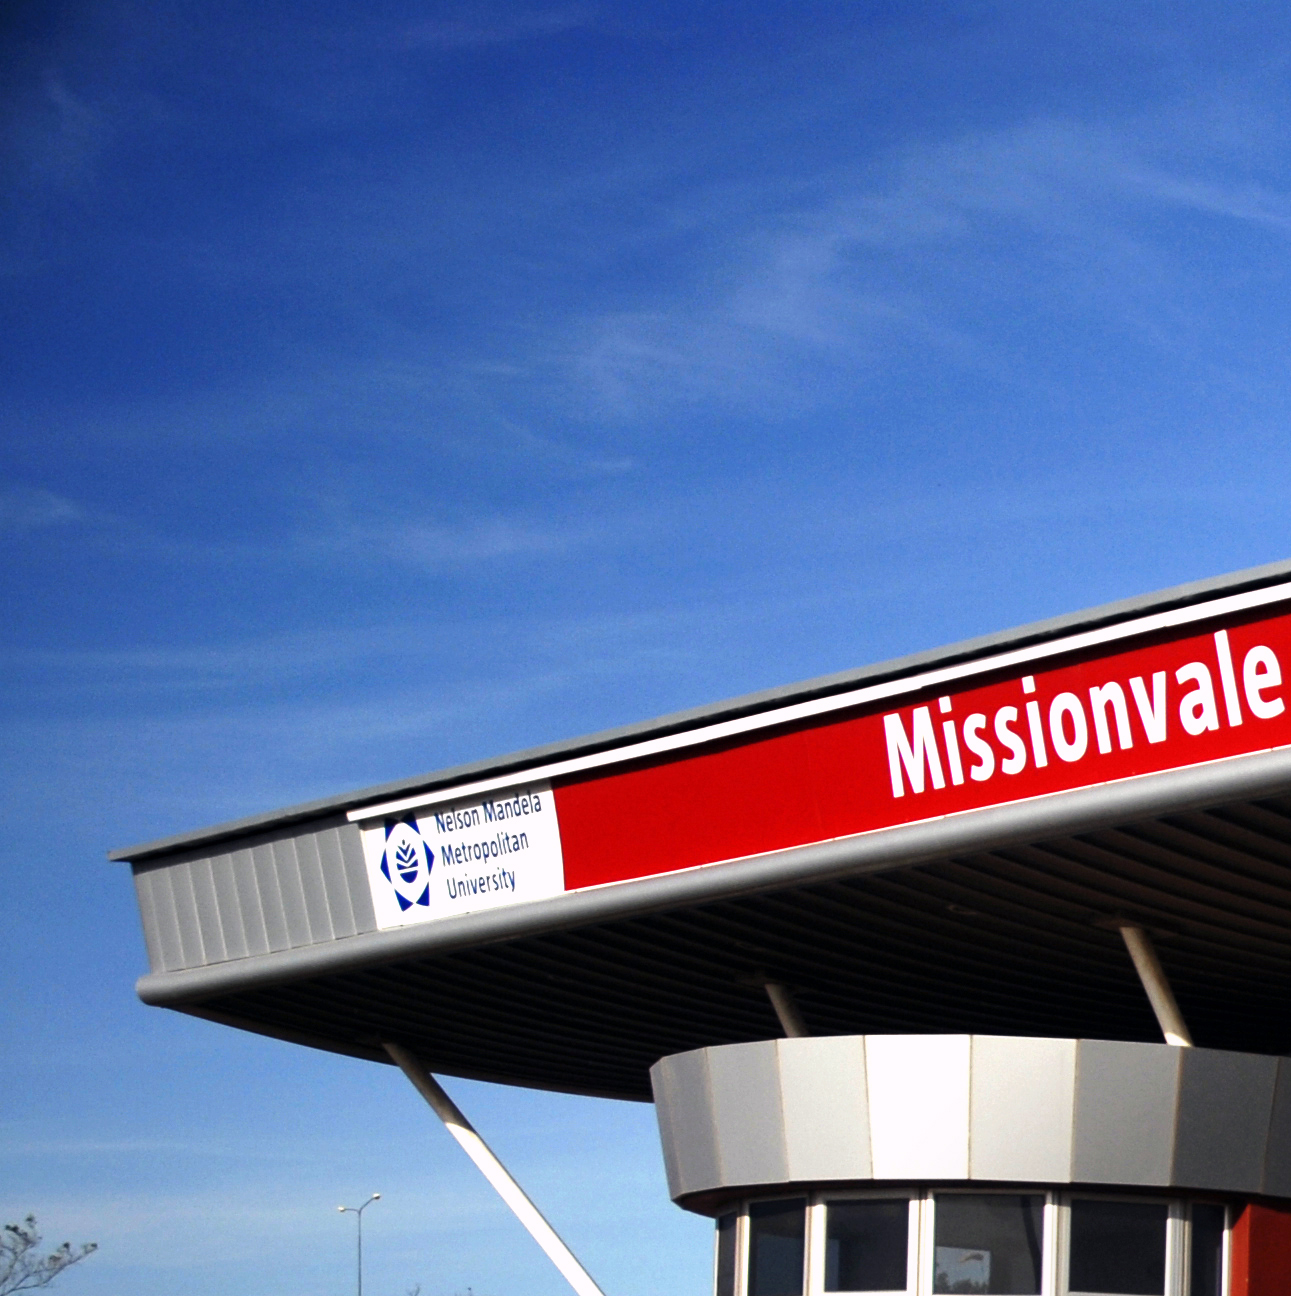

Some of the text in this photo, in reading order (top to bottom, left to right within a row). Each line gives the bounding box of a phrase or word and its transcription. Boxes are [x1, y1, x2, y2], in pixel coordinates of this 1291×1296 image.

[883, 629, 1286, 799] Missionvale
[434, 790, 542, 834] Nelson Mandela
[441, 830, 530, 867] Metropolitan
[446, 868, 516, 900] University
